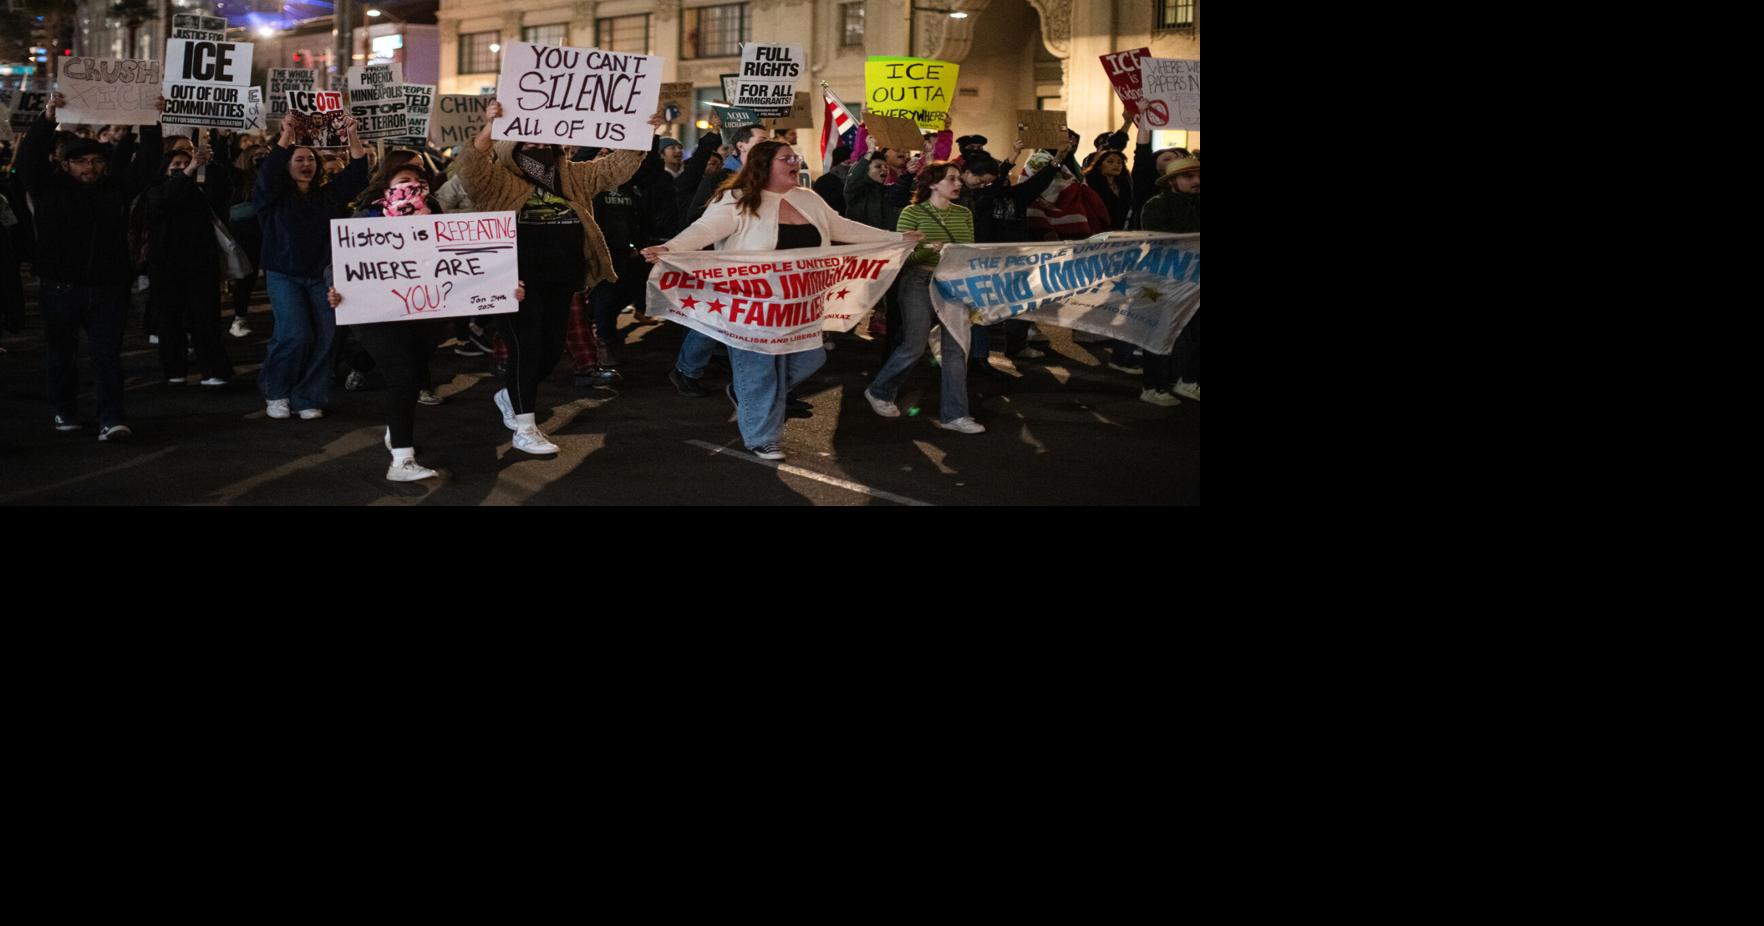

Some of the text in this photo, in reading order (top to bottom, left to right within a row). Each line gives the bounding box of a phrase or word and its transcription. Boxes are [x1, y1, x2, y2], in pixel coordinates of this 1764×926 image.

[182, 41, 236, 82] ICE
[531, 45, 647, 73] YOU CAN'T
[756, 46, 793, 61] FULL
[1106, 49, 1141, 75] ICE
[272, 69, 286, 79] THE
[744, 62, 799, 77] RIGHTS
[885, 63, 944, 80] ICE
[1143, 59, 1184, 75] WHERE
[361, 70, 393, 84] PHOENIX
[1146, 74, 1188, 95] PAPERS
[171, 84, 238, 103] OUT OF OUR
[351, 85, 403, 101] MINNEAPOLIS
[403, 85, 432, 95] EOPLE
[516, 71, 646, 114] SILENCE
[740, 84, 768, 97] FOR
[772, 85, 793, 97] ALL
[872, 86, 946, 103] OUTTA
[164, 98, 245, 117] COMMUNITIES
[404, 94, 430, 106] TED
[738, 97, 792, 105] IMMIGRANTS!
[352, 102, 406, 116] STOP
[372, 114, 406, 130] TERROR
[503, 117, 626, 141] ALL OF US
[441, 125, 485, 143] MIG
[337, 216, 516, 249] History is REPEATING
[345, 257, 485, 282] WHERE ARE
[692, 268, 723, 280] THE
[727, 261, 793, 277] PEOPLE
[796, 257, 840, 270] UNITED
[968, 256, 1002, 270] THE
[391, 281, 453, 315] YOU?
[728, 290, 826, 328] FAMILIE
[790, 331, 822, 342] LIBERAT
